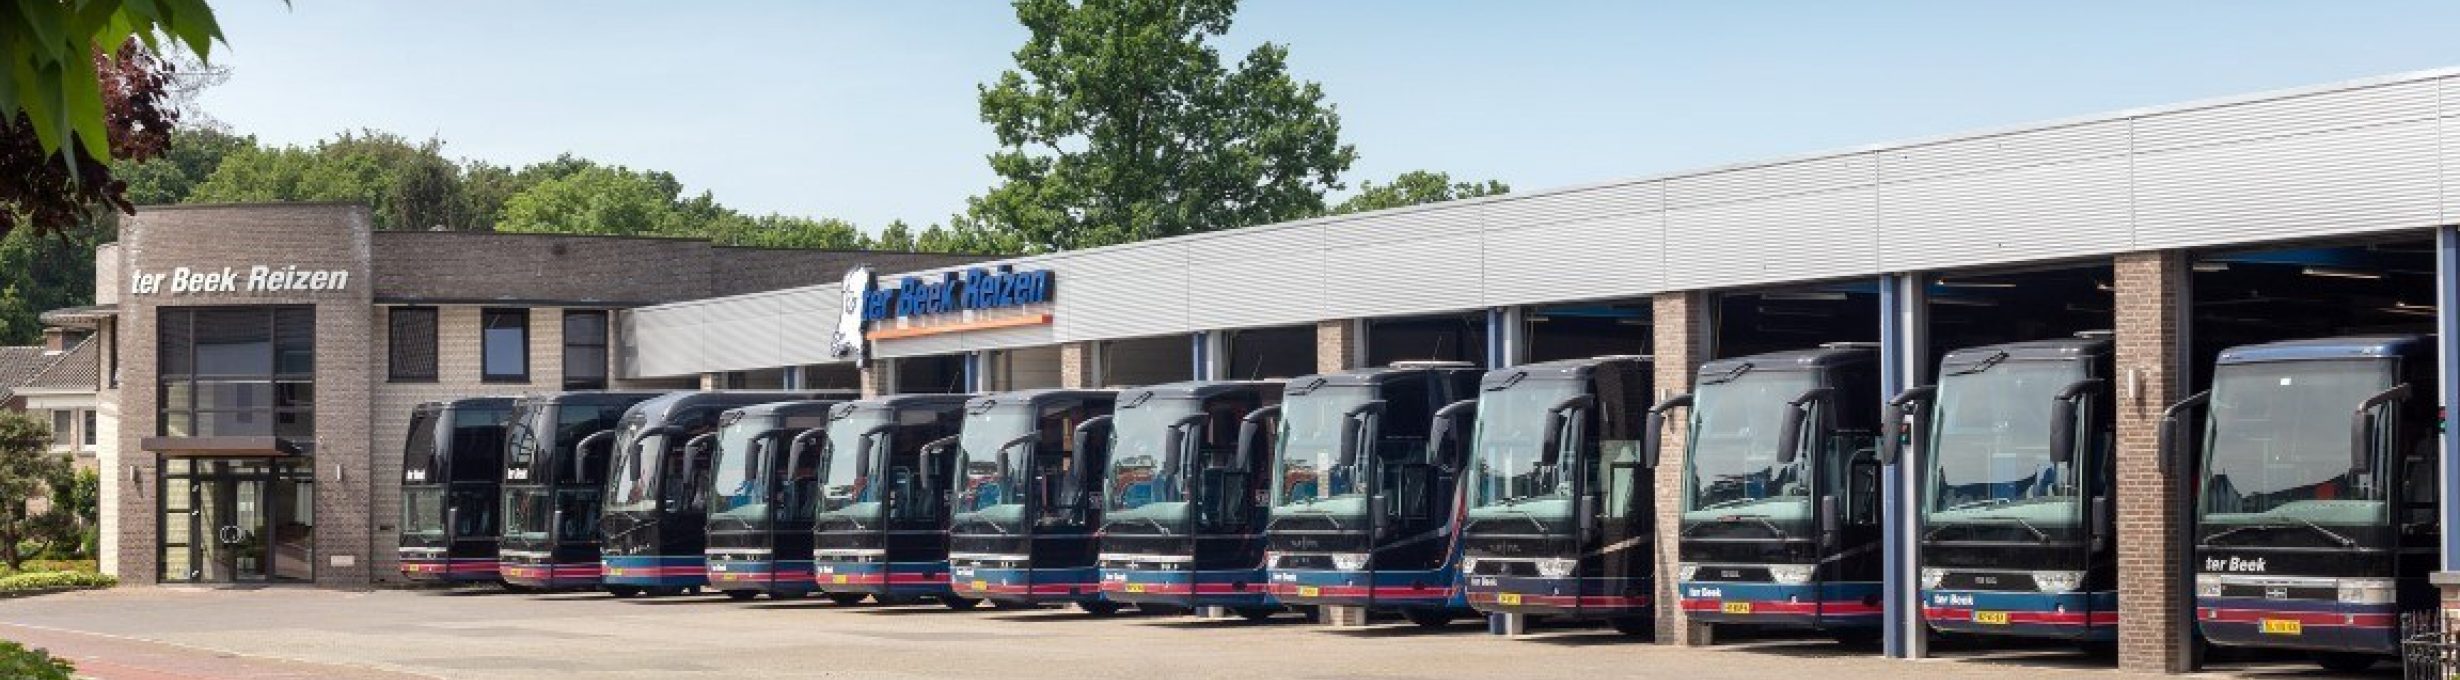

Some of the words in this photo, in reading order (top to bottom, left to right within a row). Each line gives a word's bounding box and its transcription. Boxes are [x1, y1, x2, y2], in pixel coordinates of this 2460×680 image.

[131, 268, 166, 294] ter
[171, 266, 239, 293] Beek
[248, 264, 349, 291] Reizen
[861, 288, 893, 321] ter
[897, 275, 957, 318] Beek
[961, 265, 1047, 311] Reizen
[2205, 556, 2227, 571] ter
[2229, 555, 2266, 572] Beek
